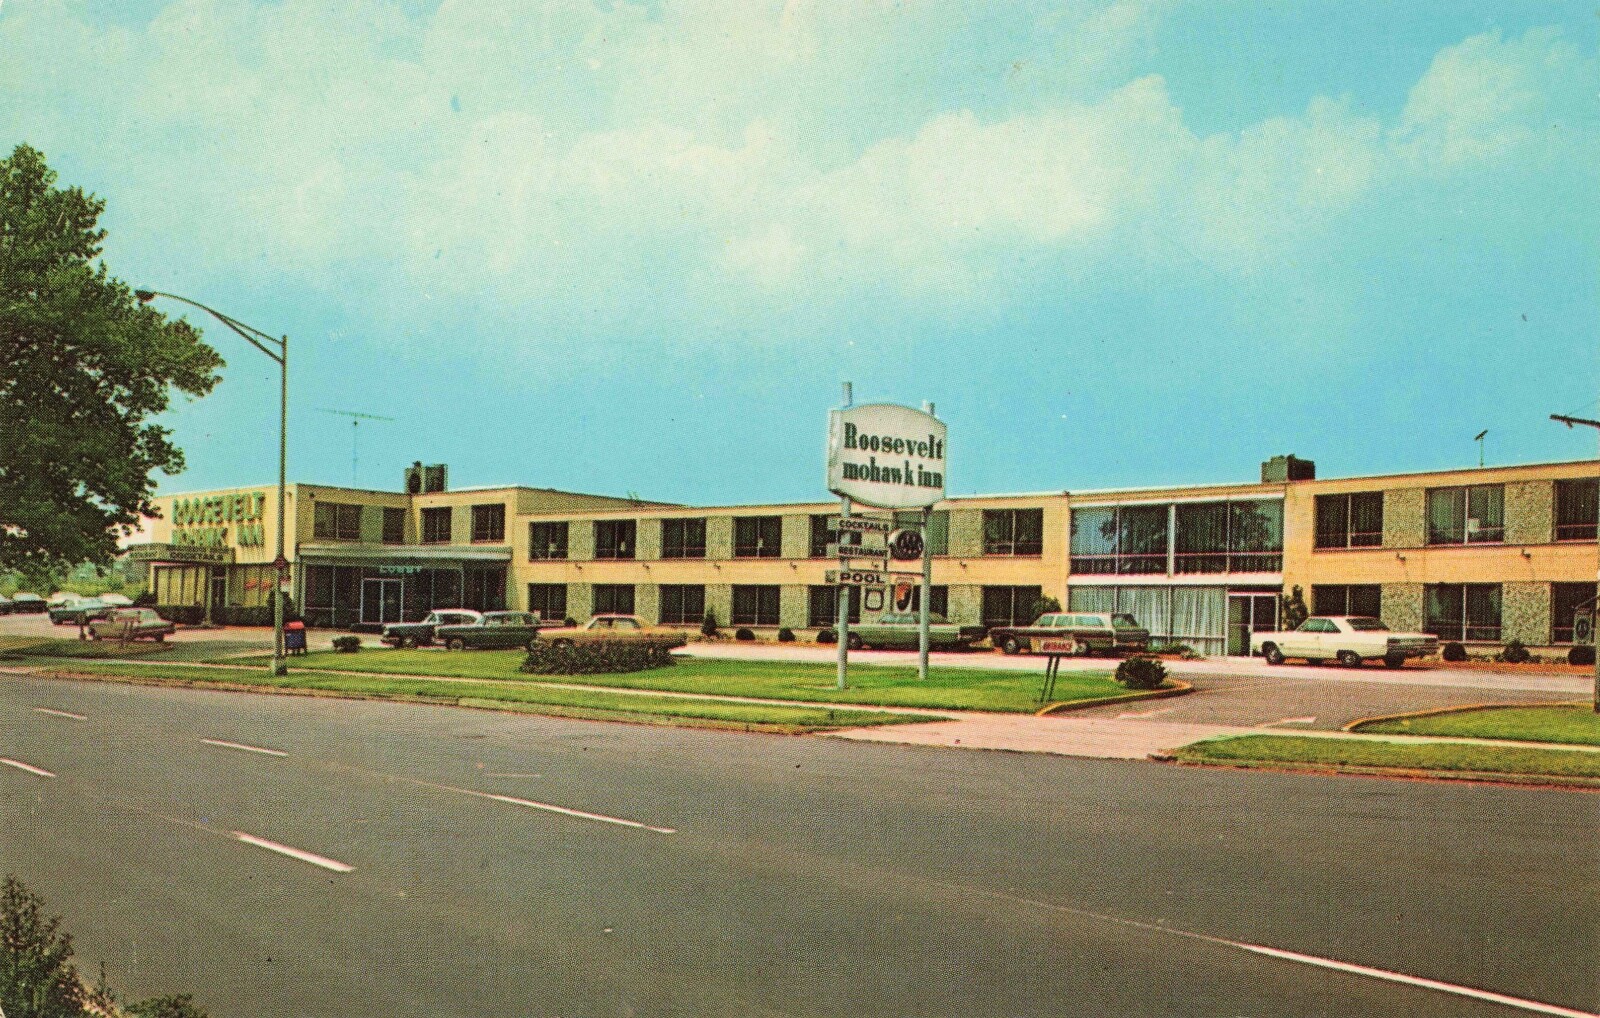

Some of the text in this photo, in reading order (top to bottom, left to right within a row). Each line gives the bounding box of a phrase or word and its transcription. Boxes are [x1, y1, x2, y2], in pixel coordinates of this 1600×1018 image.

[844, 421, 942, 460] Roosevelt
[843, 456, 942, 488] mohawk inn
[839, 520, 889, 531] COCKTAILS
[840, 572, 885, 584] POOL
